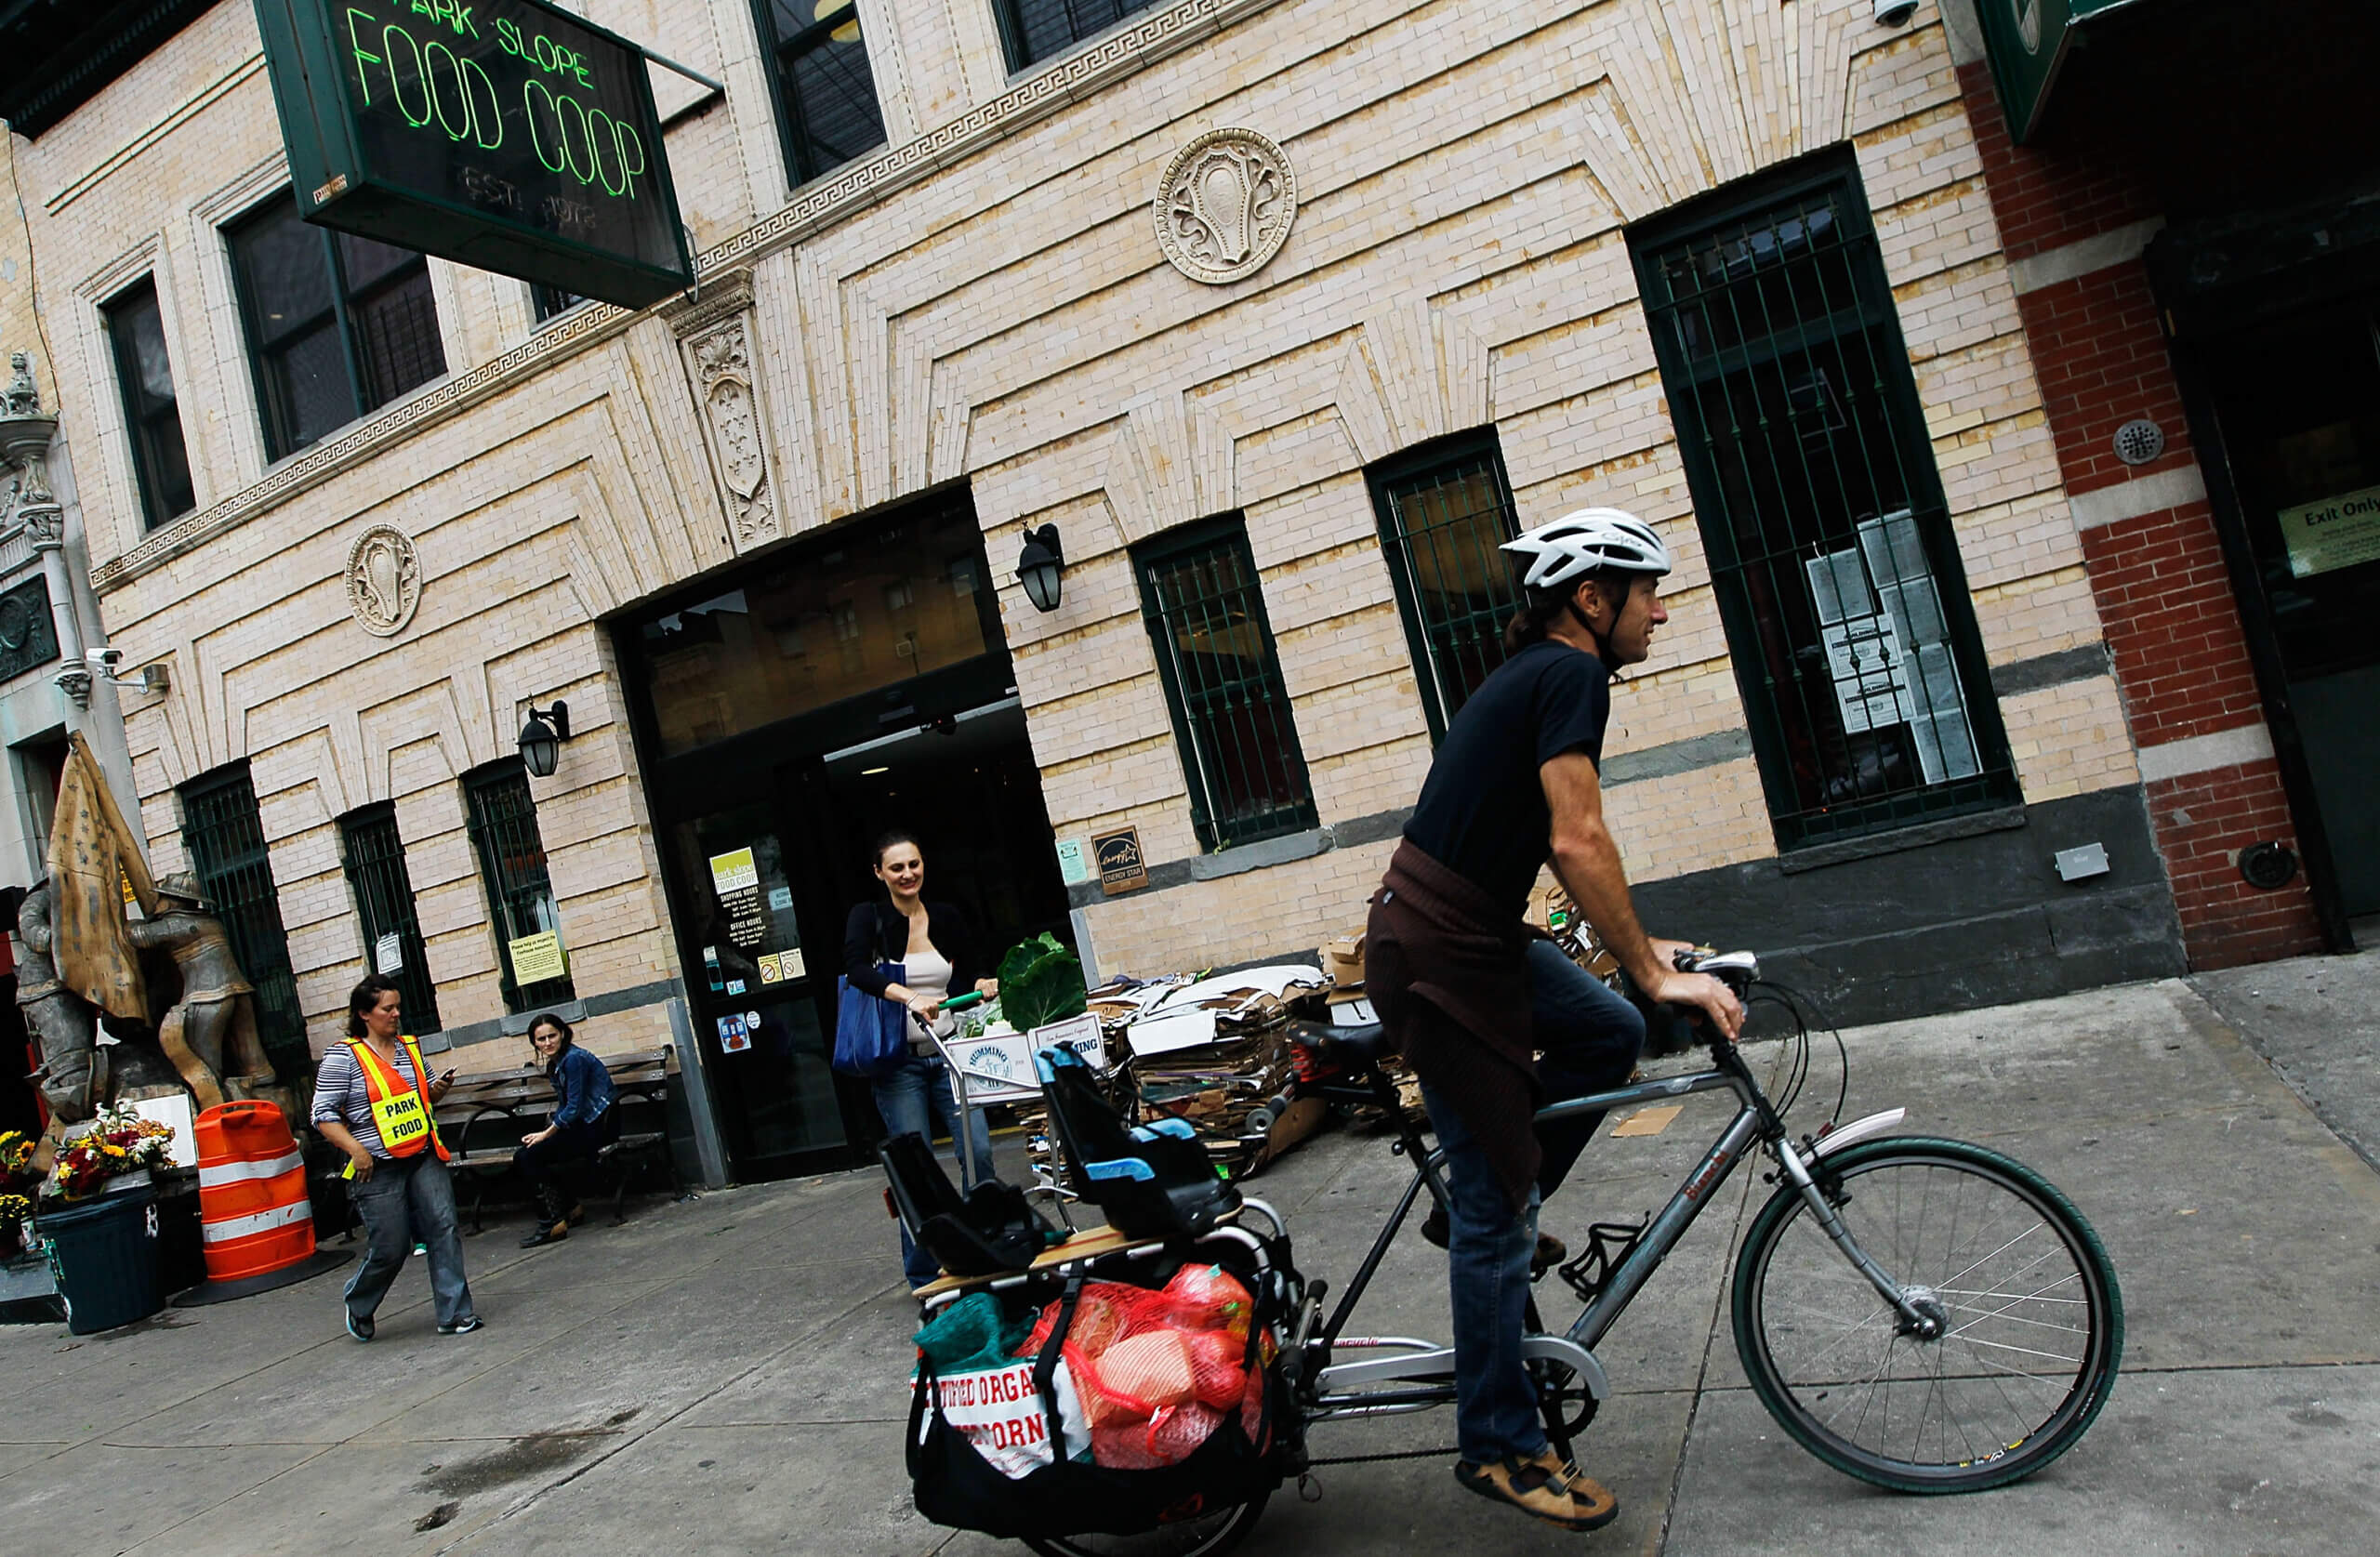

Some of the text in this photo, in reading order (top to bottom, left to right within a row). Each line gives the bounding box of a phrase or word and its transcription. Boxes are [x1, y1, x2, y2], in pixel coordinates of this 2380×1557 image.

[394, 0, 594, 90] ARK SLOPE
[346, 7, 645, 200] FOOD COOP
[2305, 507, 2340, 526] Exit
[717, 874, 757, 890] FOOD COOP
[1105, 868, 1141, 883] ENERGY STAR
[721, 886, 758, 902] SHOPPING HOURS
[730, 921, 746, 930] OFFICE
[747, 917, 762, 926] HOURS
[970, 1045, 1008, 1066] HUMMING
[385, 1097, 418, 1117] PARK
[391, 1118, 423, 1139] FOOD
